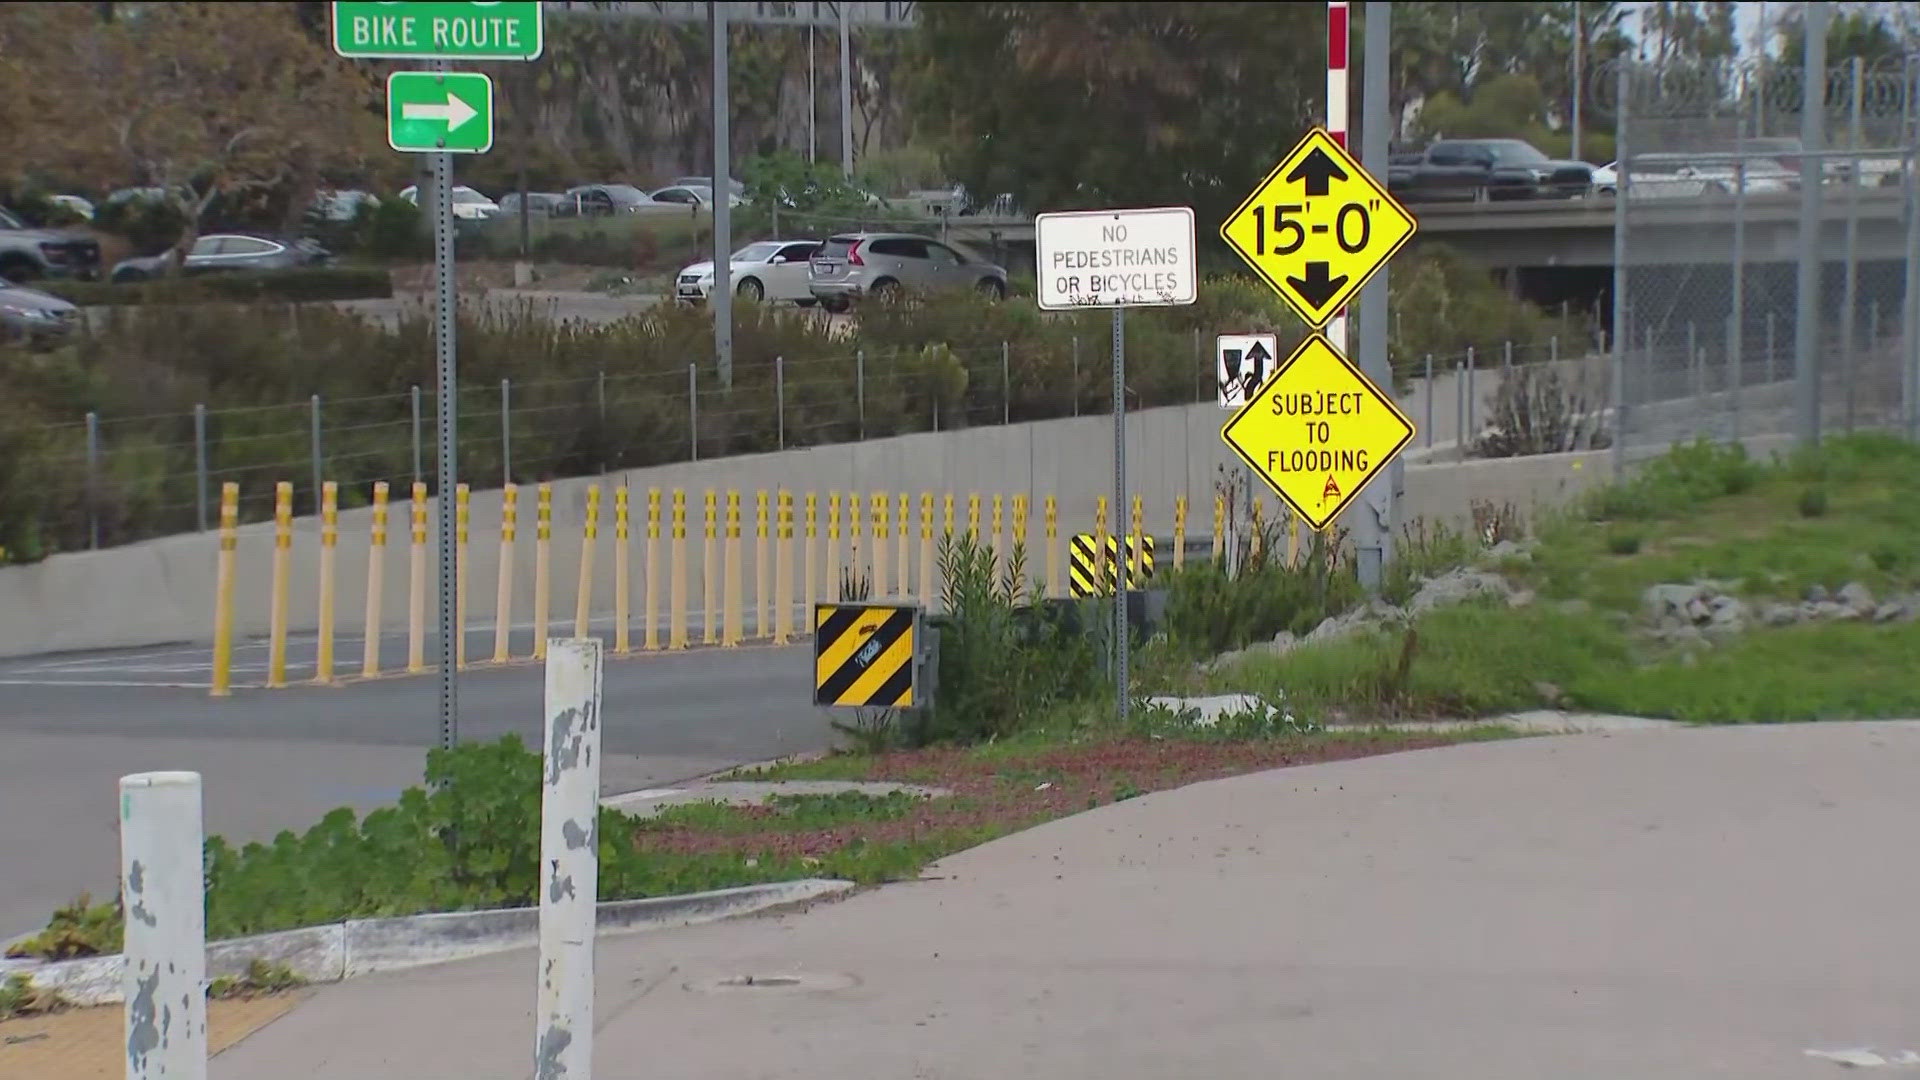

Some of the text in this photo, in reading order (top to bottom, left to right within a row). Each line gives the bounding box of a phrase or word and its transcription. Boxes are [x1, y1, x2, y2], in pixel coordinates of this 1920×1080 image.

[353, 16, 520, 47] BIKE ROUTE
[1102, 224, 1128, 243] NO
[1053, 247, 1178, 269] PEDESTRIANS
[1056, 272, 1177, 294] OR BICYCLES
[1271, 392, 1363, 416] SUBJECT
[1305, 422, 1330, 444] TO
[1267, 450, 1369, 474] FLOODING
